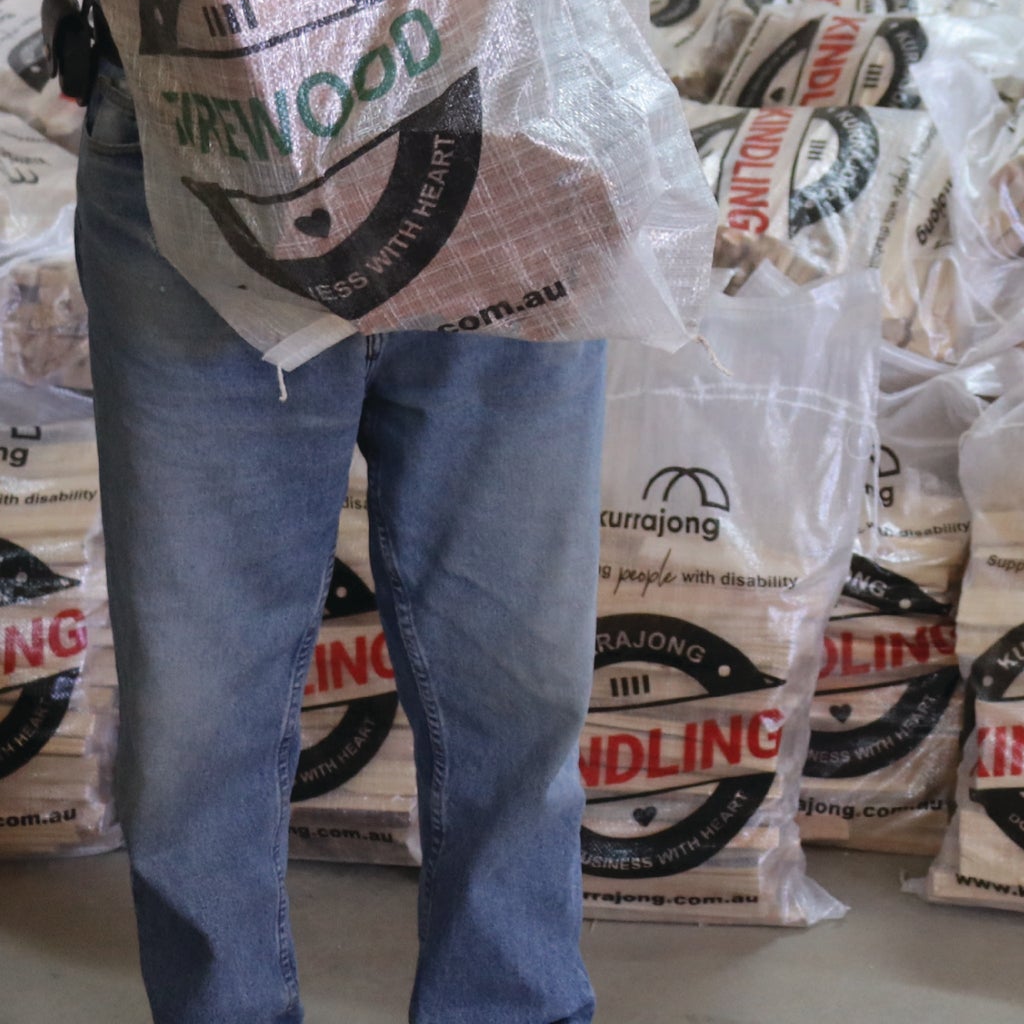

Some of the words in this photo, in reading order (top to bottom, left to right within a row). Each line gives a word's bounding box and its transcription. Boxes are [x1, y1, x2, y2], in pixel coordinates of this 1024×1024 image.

[800, 15, 867, 106] KINDL
[366, 220, 423, 274] WITH
[419, 133, 456, 218] HEART
[727, 107, 794, 235] KINDLING
[24, 489, 98, 505] disability
[613, 548, 675, 598] people
[681, 569, 716, 586] with
[720, 574, 798, 591] disability
[594, 629, 707, 664] RAJONG
[816, 619, 958, 680] DLING
[301, 759, 337, 784] WITH
[338, 717, 374, 764] HEART
[578, 707, 784, 788] NDLING
[582, 850, 654, 872] USINESS
[656, 836, 701, 866] WITH
[700, 788, 749, 840] HEART
[583, 890, 759, 907] rrajong.com.au
